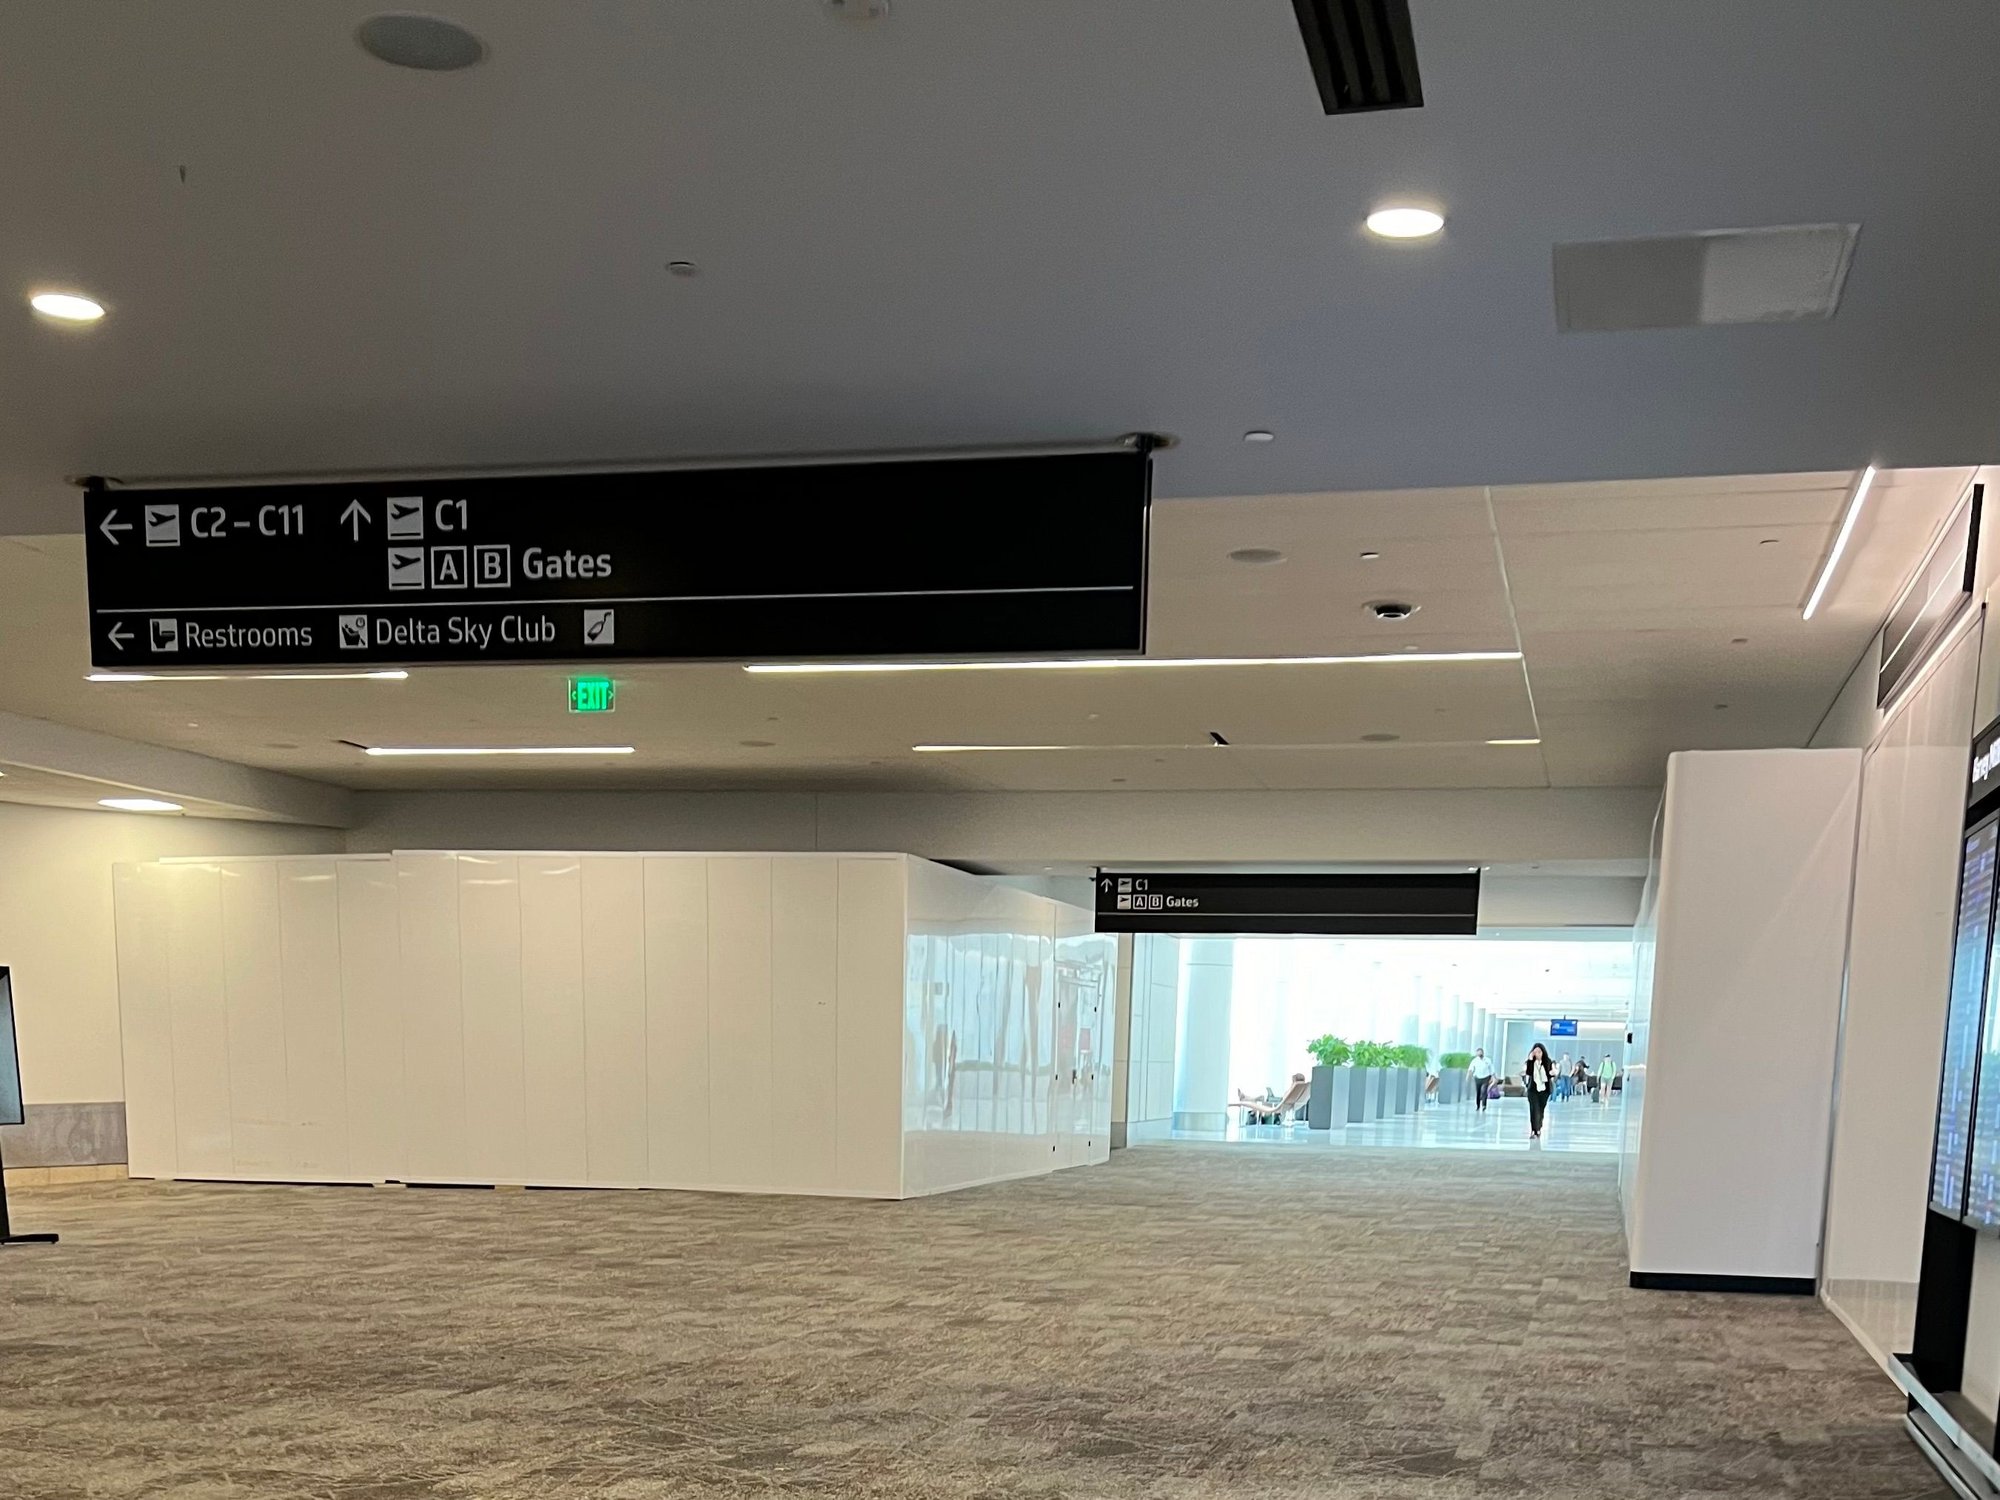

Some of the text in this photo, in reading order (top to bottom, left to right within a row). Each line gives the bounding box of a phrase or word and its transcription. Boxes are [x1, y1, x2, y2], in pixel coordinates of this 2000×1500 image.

[190, 506, 227, 538] C2
[258, 504, 304, 536] C11
[435, 499, 468, 531] C1
[439, 547, 612, 581] A B Gates
[185, 622, 313, 648] Restrooms
[376, 614, 556, 649] Delta Sky Club
[577, 681, 609, 710] EXIT
[1135, 878, 1148, 891] C1
[1166, 895, 1199, 908] Gates
